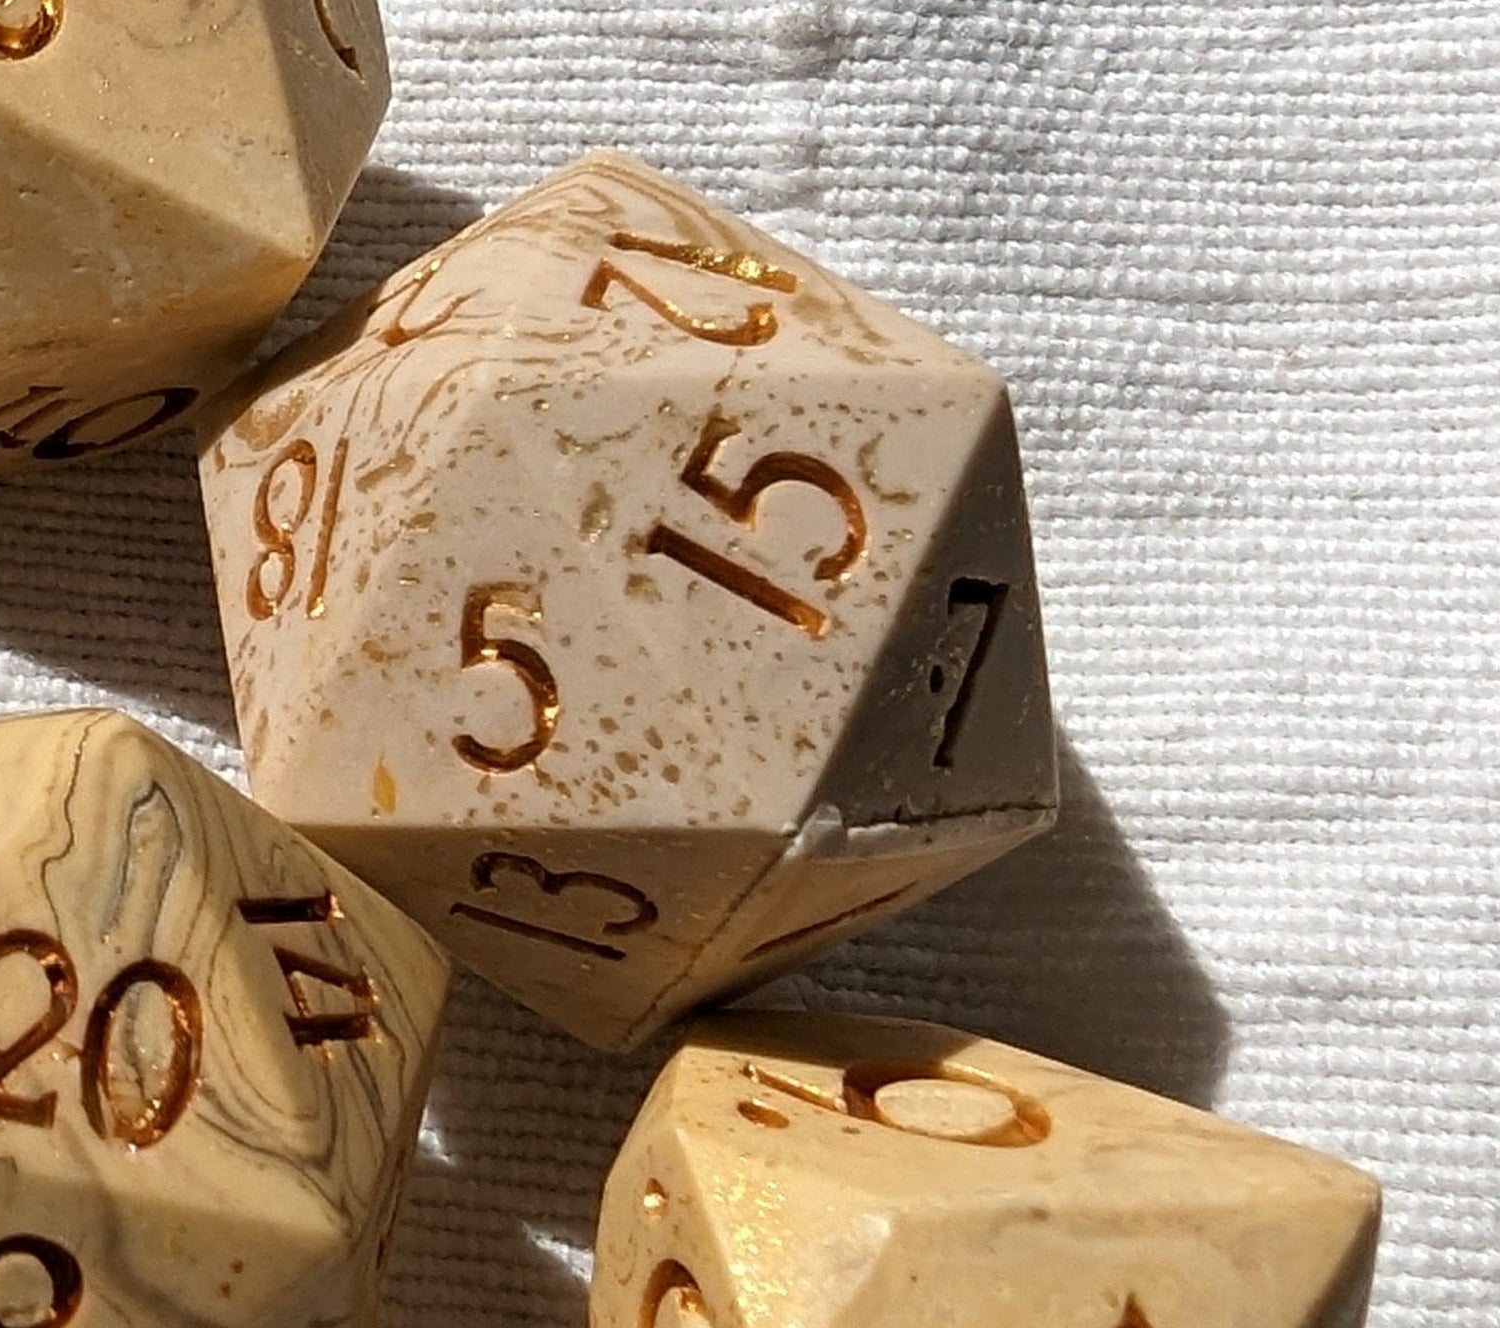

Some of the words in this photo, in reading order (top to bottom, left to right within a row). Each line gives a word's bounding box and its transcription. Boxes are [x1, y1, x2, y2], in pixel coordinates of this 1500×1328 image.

[581, 231, 799, 347] 12
[644, 414, 870, 639] 15
[450, 582, 561, 775] 5
[932, 576, 1011, 771] 7
[450, 851, 659, 963] 13
